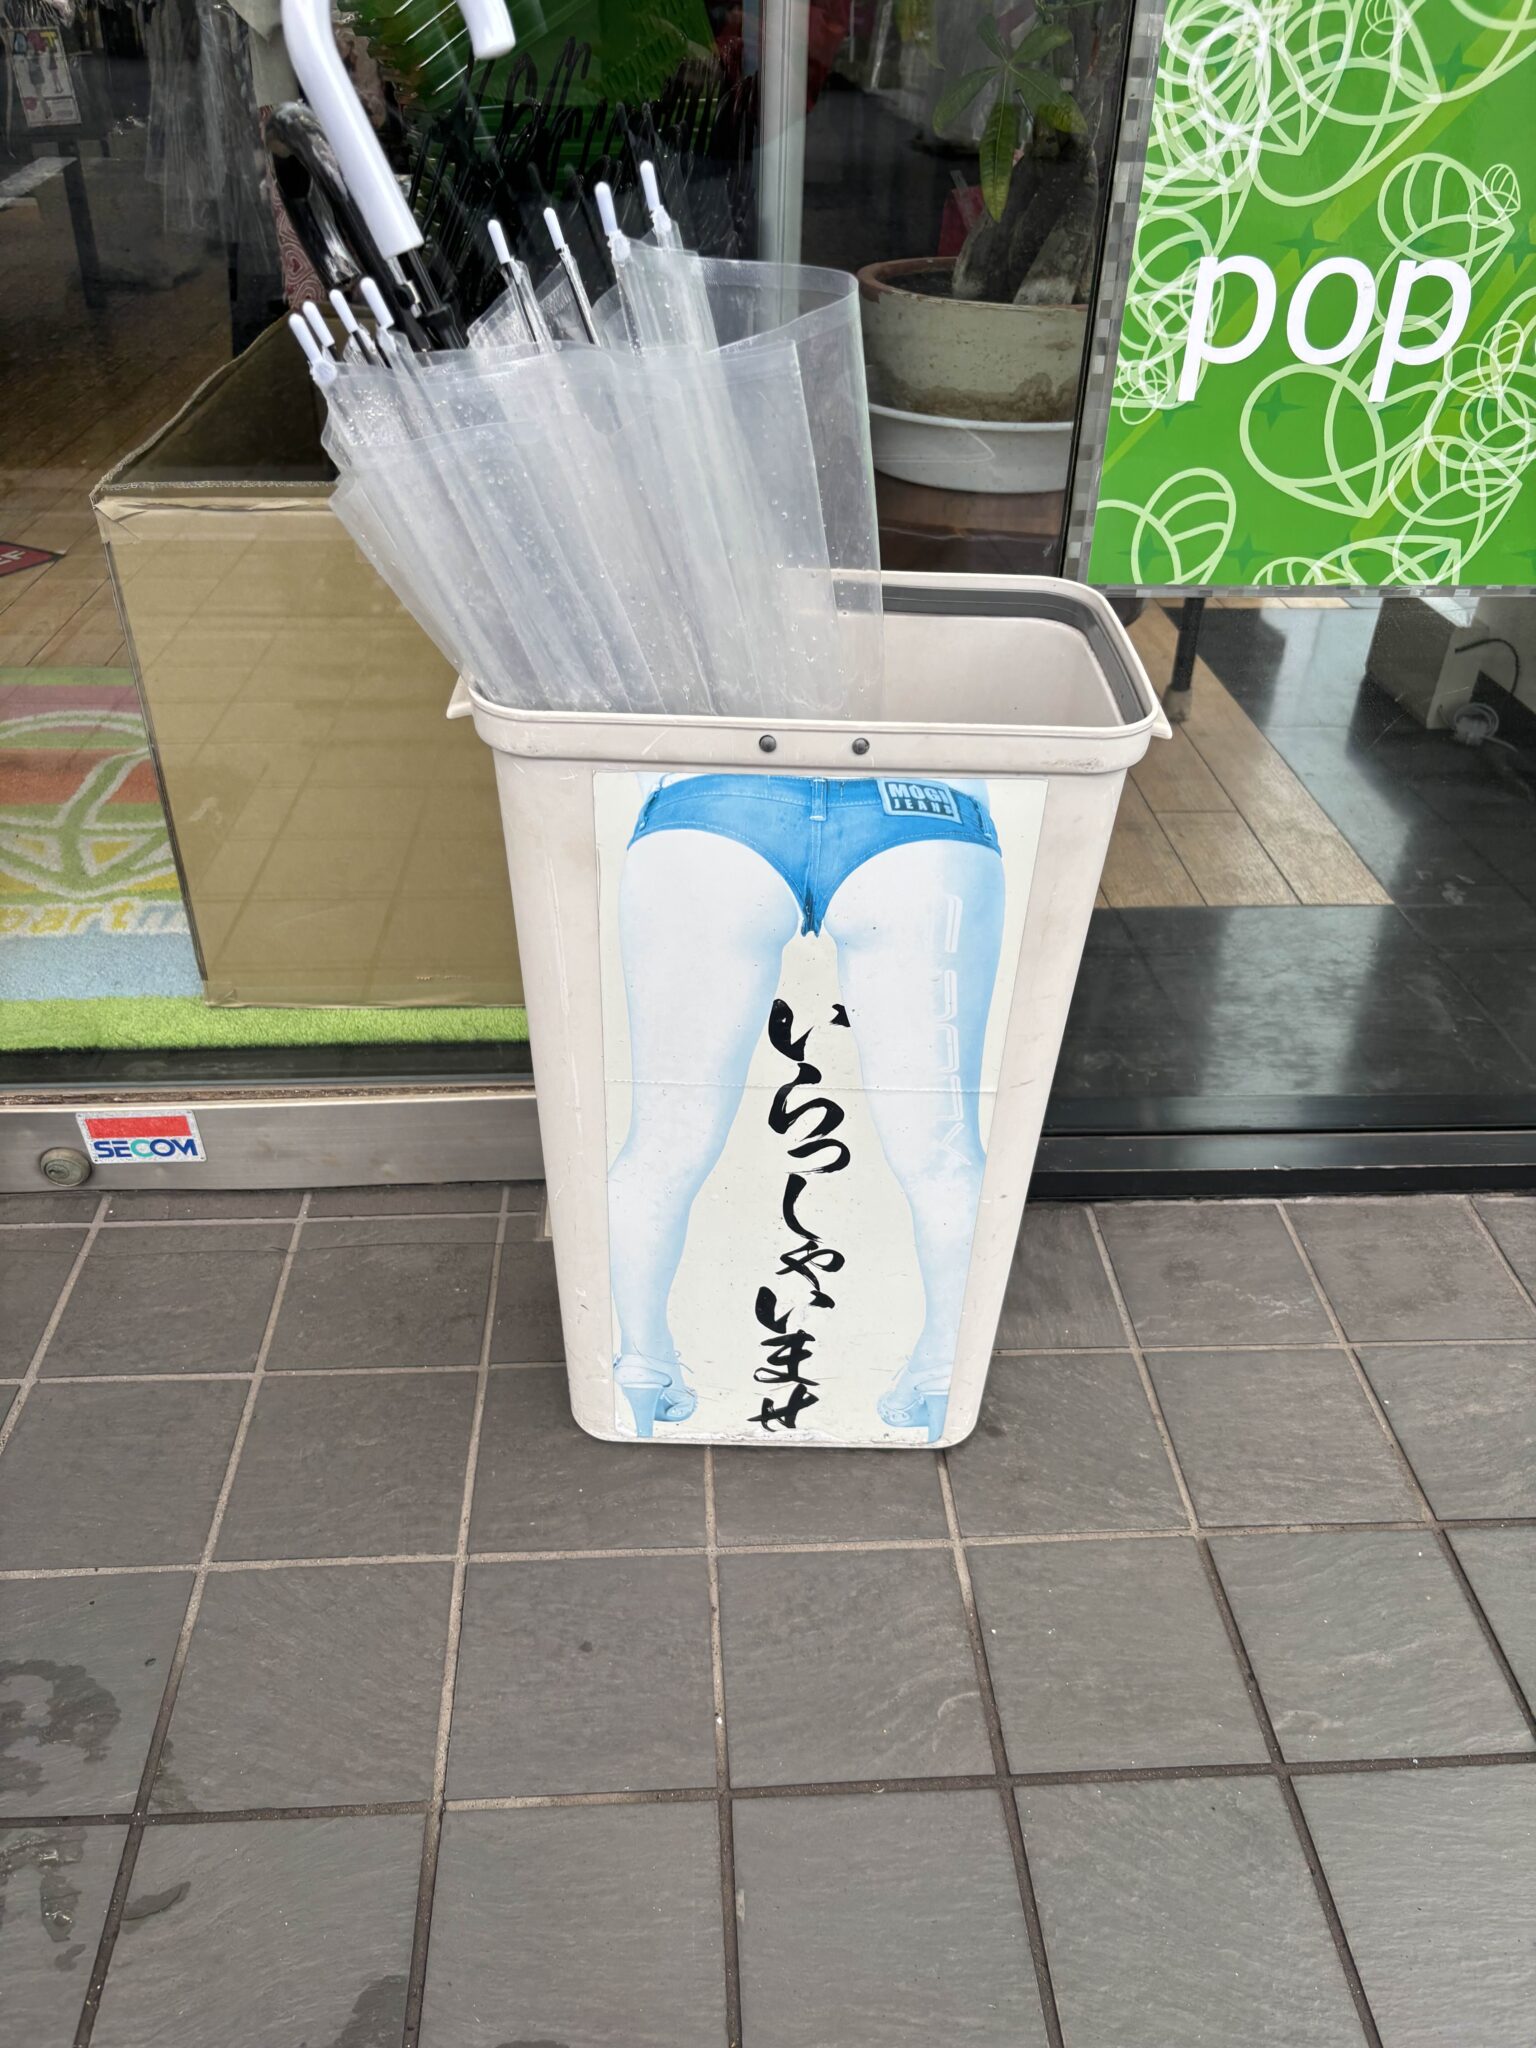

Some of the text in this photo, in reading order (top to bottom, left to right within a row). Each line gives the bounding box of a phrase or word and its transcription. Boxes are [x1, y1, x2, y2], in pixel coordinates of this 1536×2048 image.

[1177, 255, 1472, 403] pop
[887, 783, 950, 804] MOGI
[93, 1138, 199, 1158] SECOM
